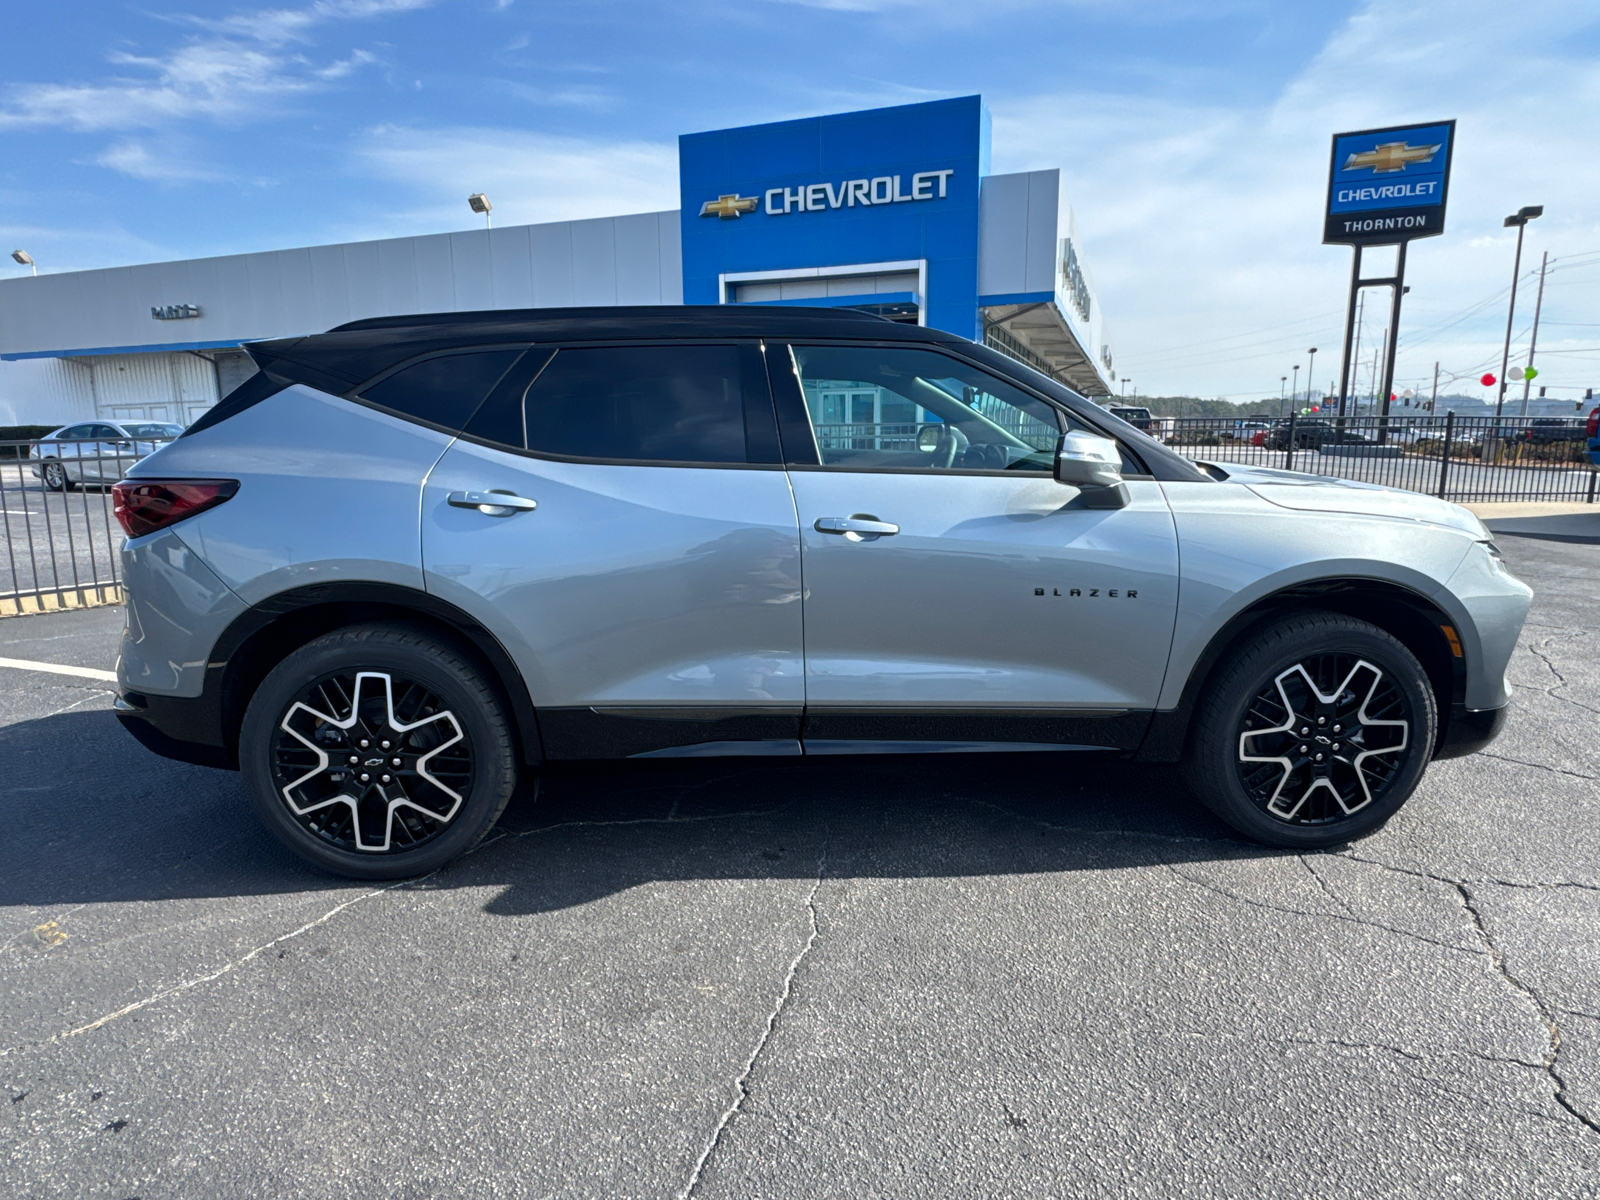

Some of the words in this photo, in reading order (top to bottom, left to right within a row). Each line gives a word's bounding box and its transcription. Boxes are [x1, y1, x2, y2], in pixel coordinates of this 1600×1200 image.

[765, 169, 953, 215] CHEVROLET
[1338, 181, 1437, 202] CHEVROLET
[1344, 215, 1426, 232] THORNTON
[151, 304, 197, 319] PARTS
[1034, 587, 1138, 598] BLAZER
